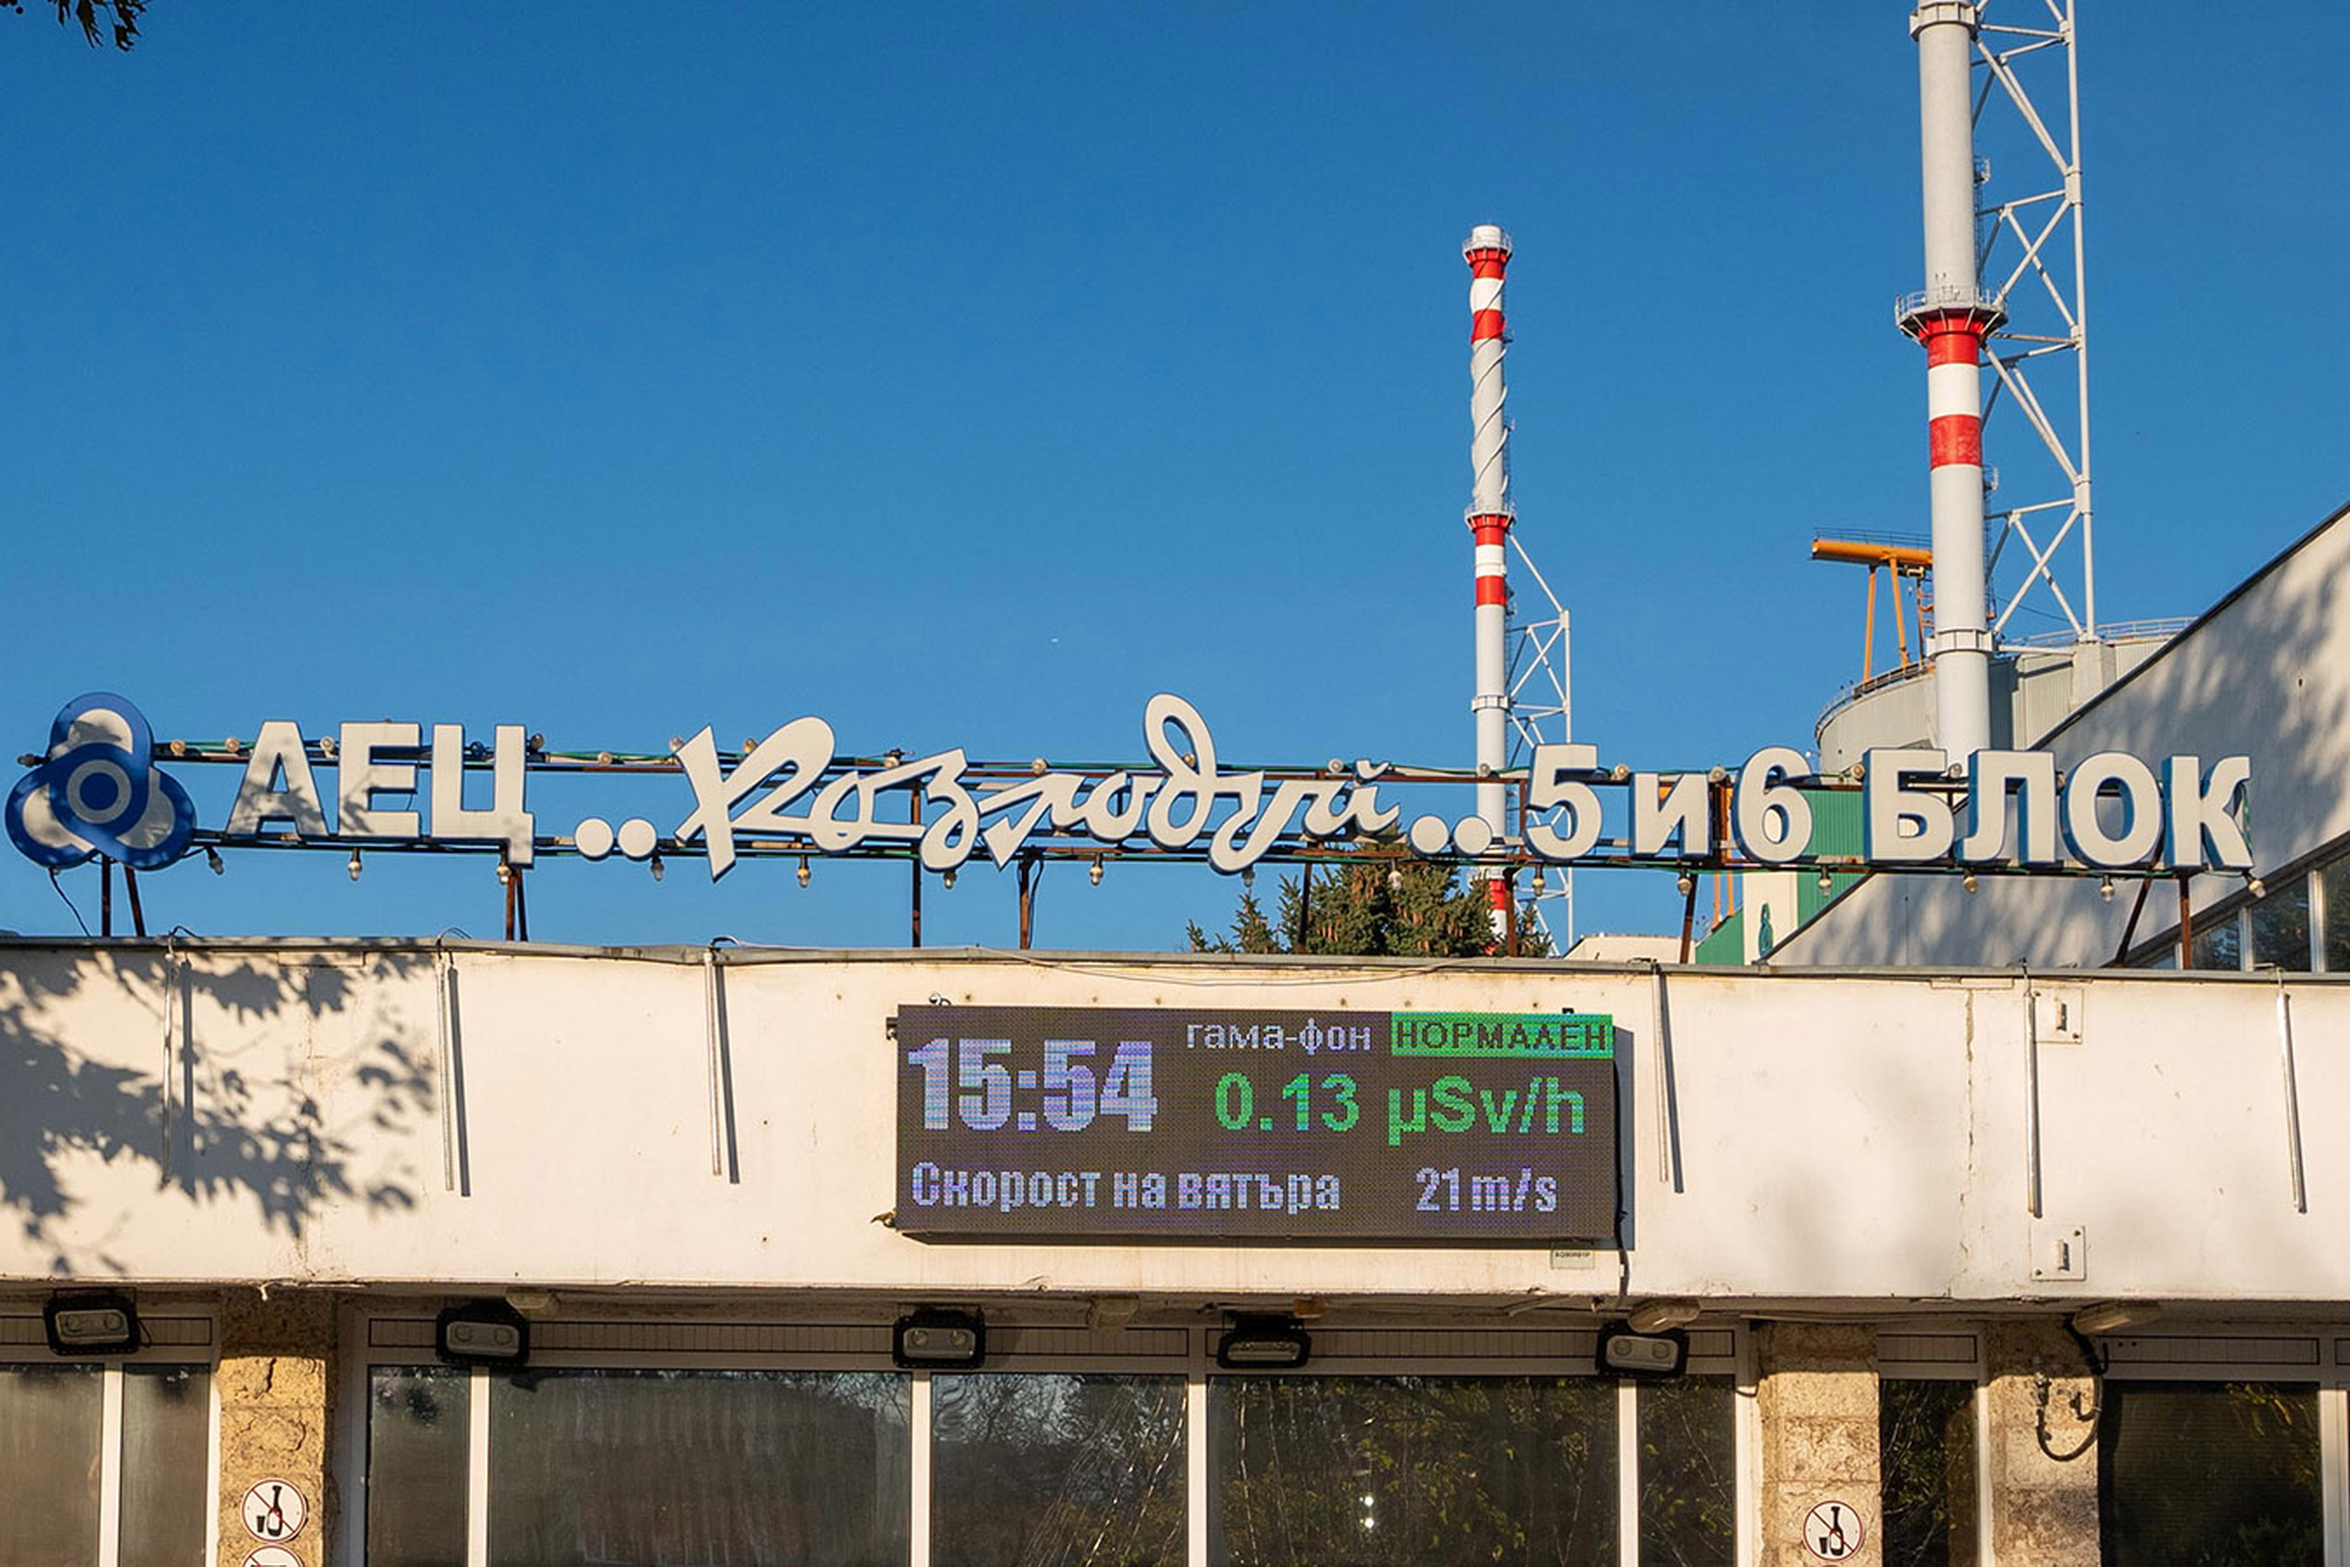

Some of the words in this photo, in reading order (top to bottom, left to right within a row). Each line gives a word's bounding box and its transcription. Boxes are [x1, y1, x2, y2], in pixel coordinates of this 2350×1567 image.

[225, 720, 534, 869] АЕЦ
[1862, 747, 2255, 871] БЛОК
[1186, 1017, 1372, 1056] гама-фон
[1397, 1020, 1608, 1053] НОРМАЛЕН
[908, 1037, 1159, 1133] 15:54
[1214, 1072, 1360, 1132] 0.13
[912, 1162, 1101, 1213] Скорост
[1113, 1172, 1167, 1210] на
[1178, 1173, 1341, 1215] вятъра
[1416, 1166, 1460, 1212] 21
[1472, 1166, 1558, 1213] m/s
